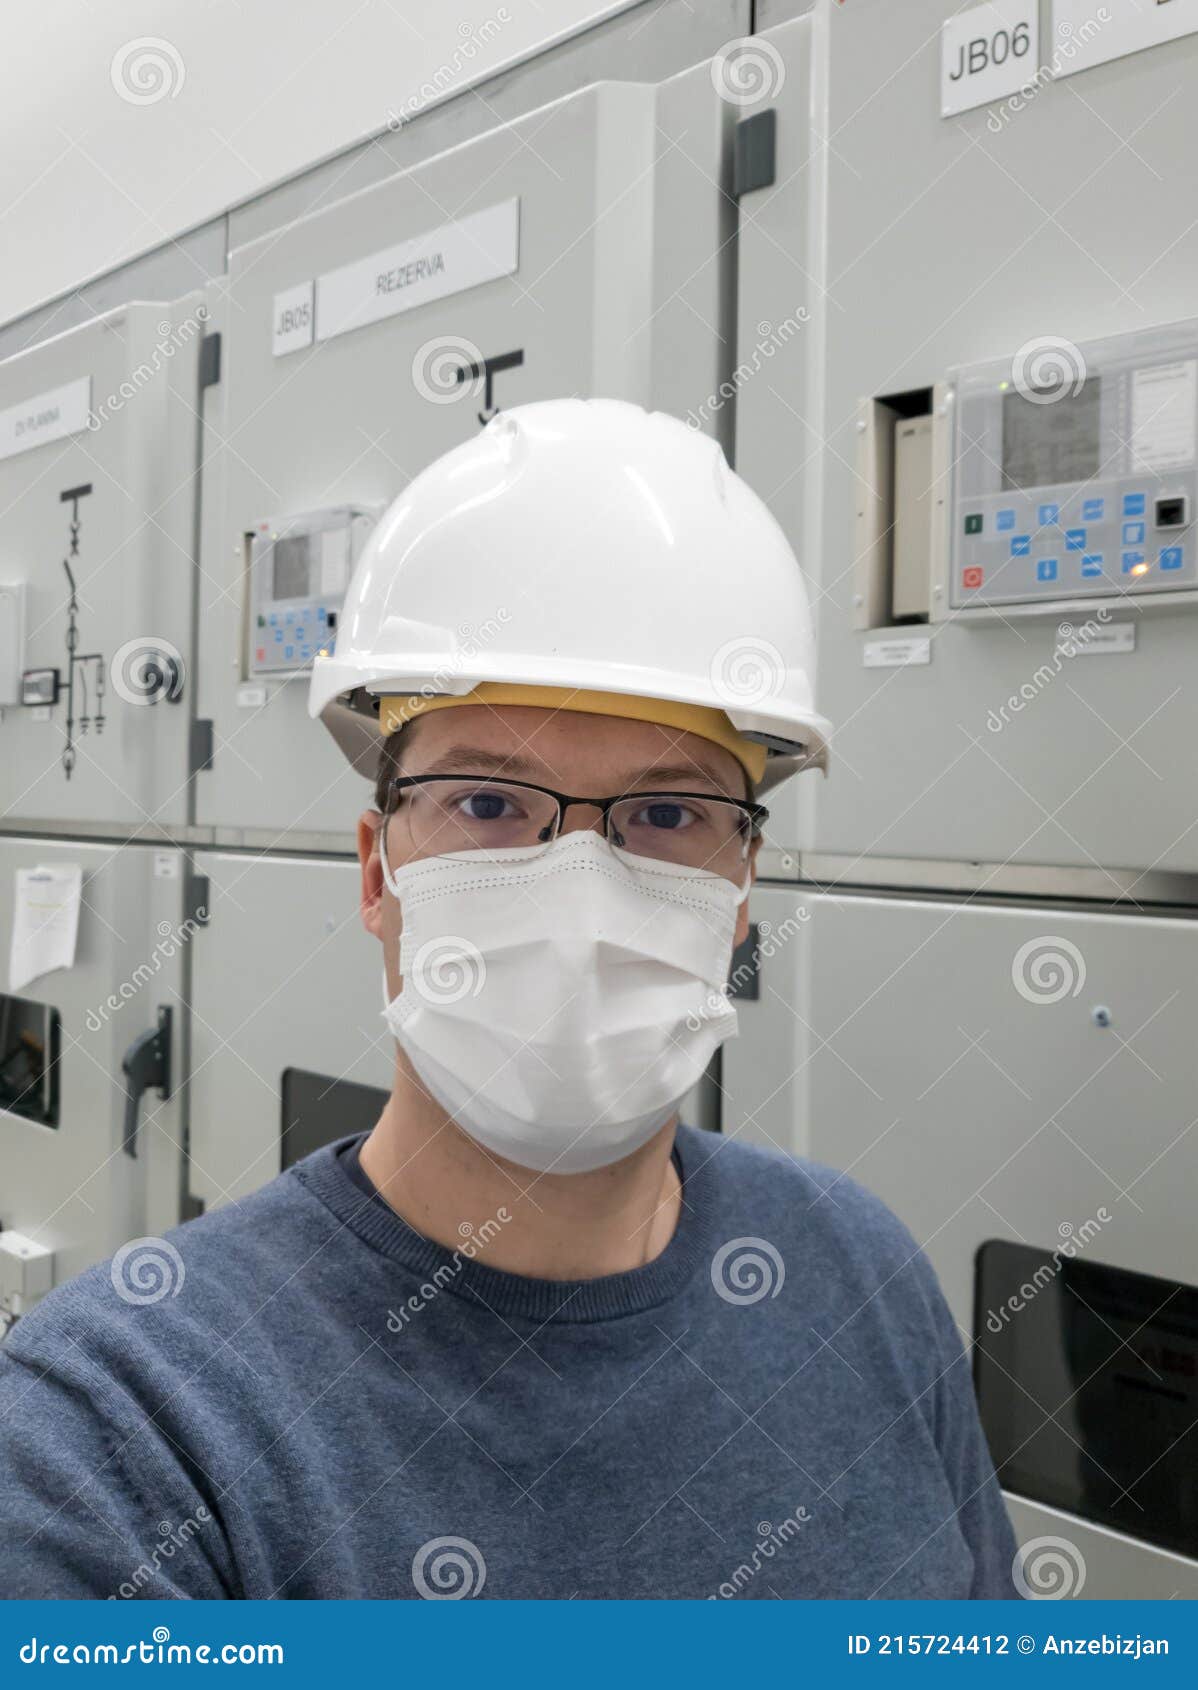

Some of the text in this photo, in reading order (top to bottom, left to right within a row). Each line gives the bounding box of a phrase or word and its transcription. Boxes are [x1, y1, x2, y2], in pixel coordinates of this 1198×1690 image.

[949, 21, 1030, 81] JB06
[375, 251, 446, 297] REZERVA
[276, 302, 311, 337] JB05
